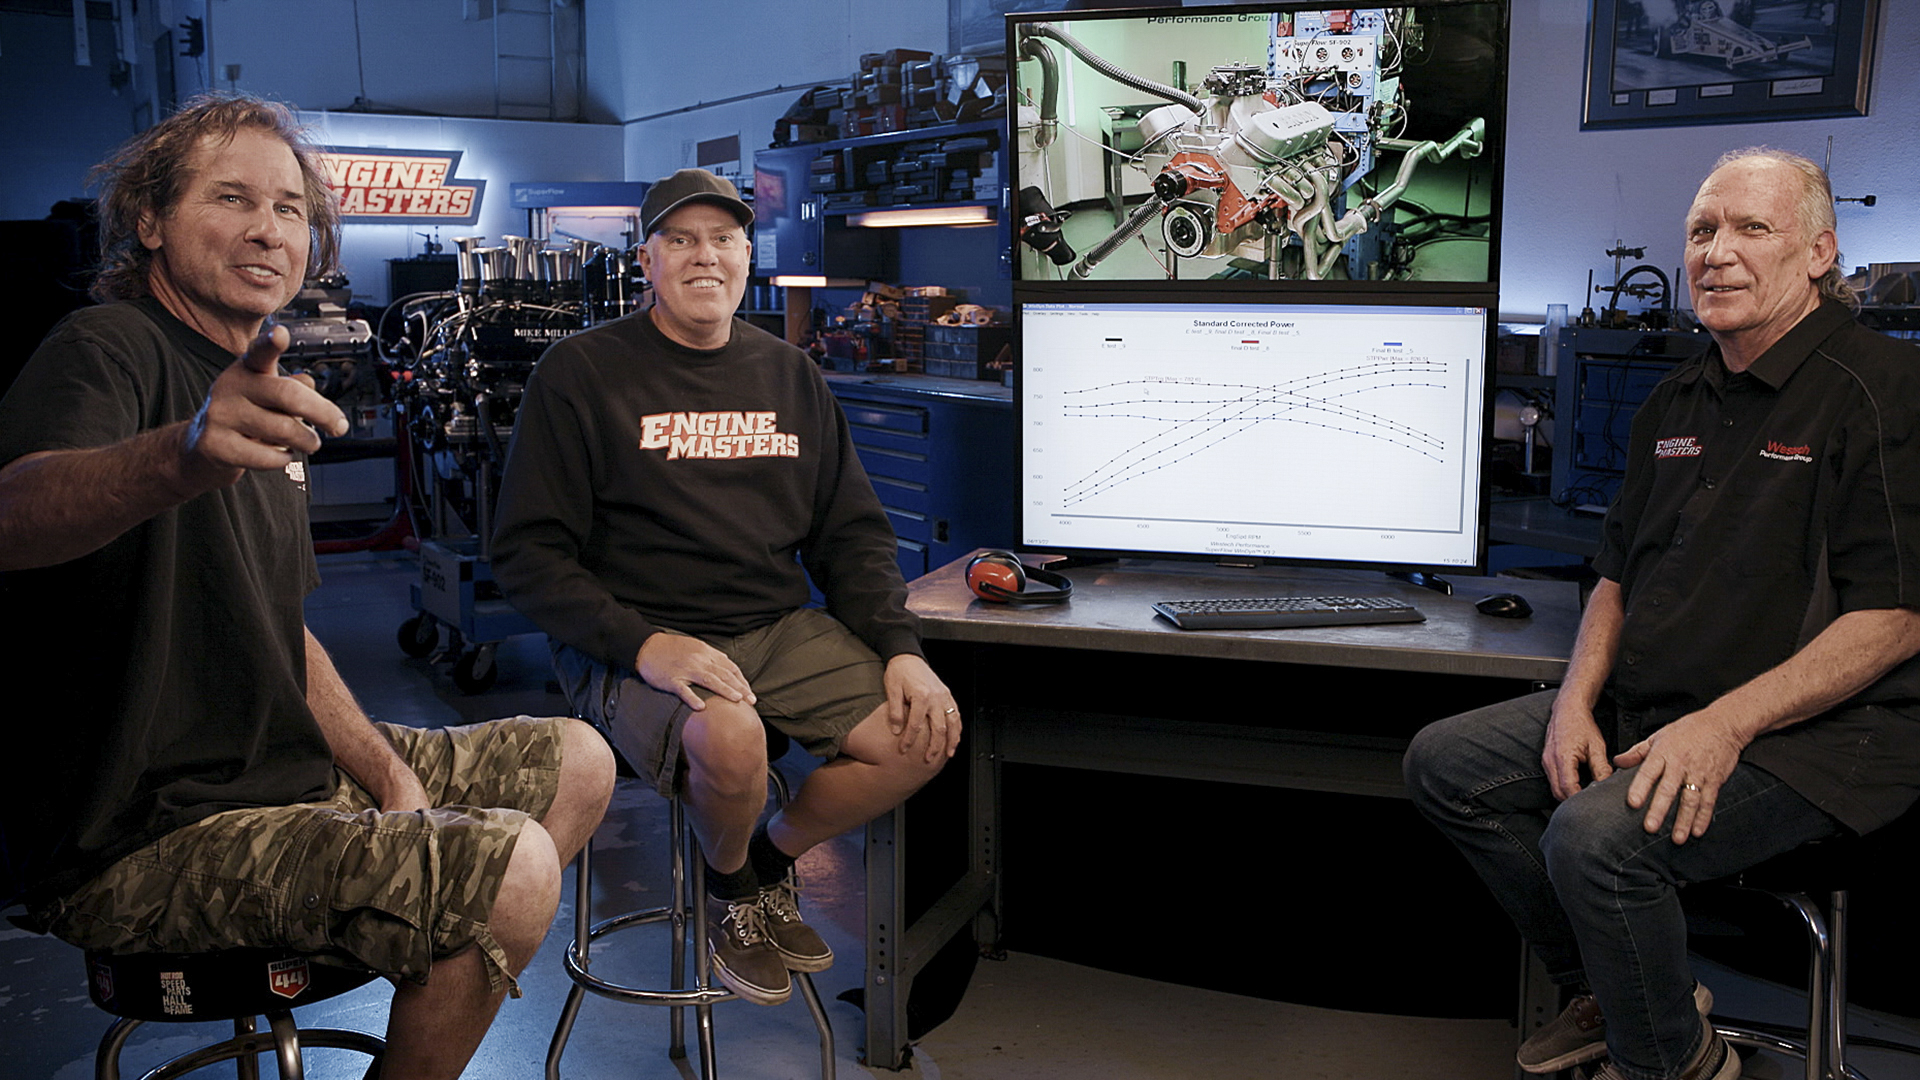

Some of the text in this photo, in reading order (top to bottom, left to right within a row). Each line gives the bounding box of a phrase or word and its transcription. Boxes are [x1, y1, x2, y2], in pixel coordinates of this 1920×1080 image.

[1147, 13, 1274, 24] Performance Grou
[324, 158, 446, 189] NGINE
[1193, 320, 1228, 328] Standard
[1230, 320, 1268, 328] Corrected
[514, 328, 541, 337] MIKE
[640, 412, 777, 449] ENGINE
[667, 433, 799, 460] MASTERS
[1655, 437, 1696, 454] ENGINE
[1658, 446, 1702, 458] MASTERS
[270, 958, 306, 971] SUPER
[160, 979, 186, 989] SPEED
[275, 971, 304, 988] 44
[166, 986, 191, 996] PARTS
[162, 995, 188, 1007] HALL
[170, 1004, 193, 1015] FAME
